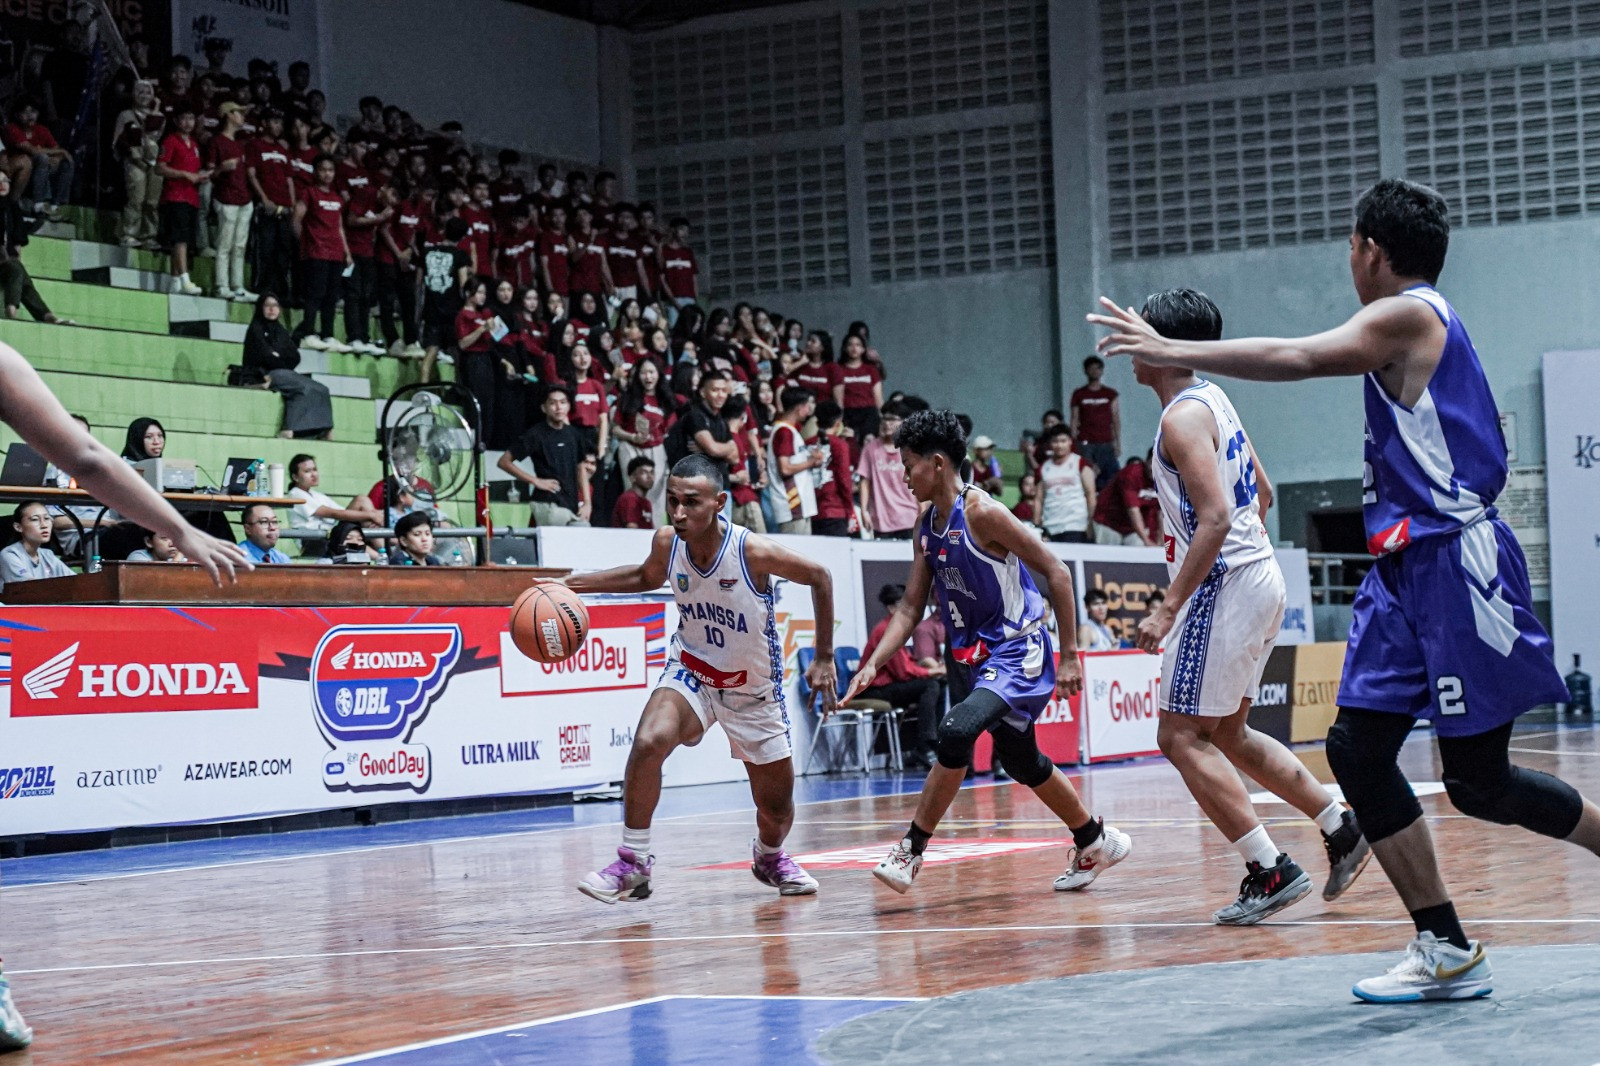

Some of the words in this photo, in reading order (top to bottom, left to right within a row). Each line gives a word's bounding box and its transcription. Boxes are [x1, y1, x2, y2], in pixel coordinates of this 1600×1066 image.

[704, 624, 725, 649] 10
[353, 651, 427, 670] HONDA
[78, 662, 250, 698] HONDA
[353, 687, 391, 715] DBL
[1437, 676, 1467, 716] 2
[559, 726, 579, 746] HOT
[461, 744, 505, 766] ULTRA
[506, 740, 541, 762] MILK
[560, 745, 591, 764] CREAM
[183, 758, 292, 782] AZAWEAR.COM
[20, 788, 55, 797] INDONESIA
